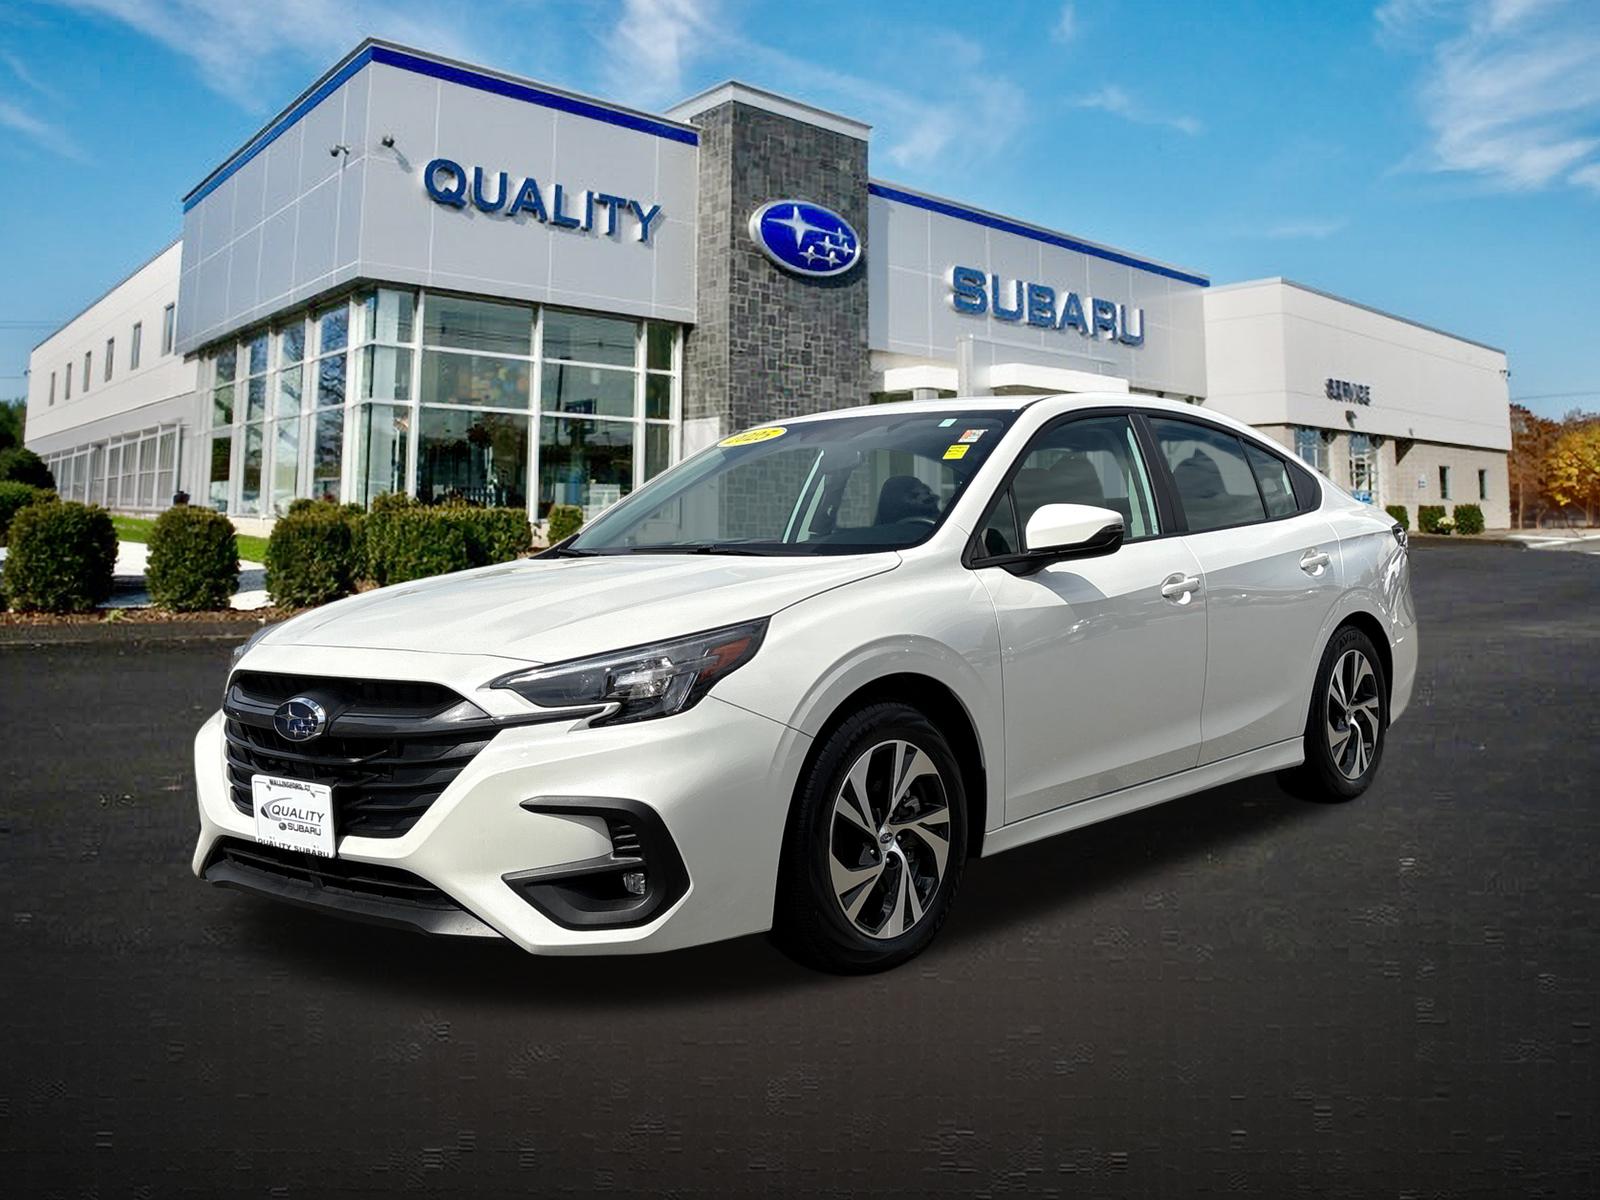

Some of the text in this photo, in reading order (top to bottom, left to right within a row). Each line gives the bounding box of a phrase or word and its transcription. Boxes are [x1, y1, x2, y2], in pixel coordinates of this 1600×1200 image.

[424, 158, 662, 243] QUALITY
[949, 264, 1145, 347] SUBARU
[1325, 378, 1371, 406] SERVICE
[271, 804, 325, 823] QUALITY
[287, 822, 321, 836] SUBARU
[293, 845, 330, 858] SUBARU
